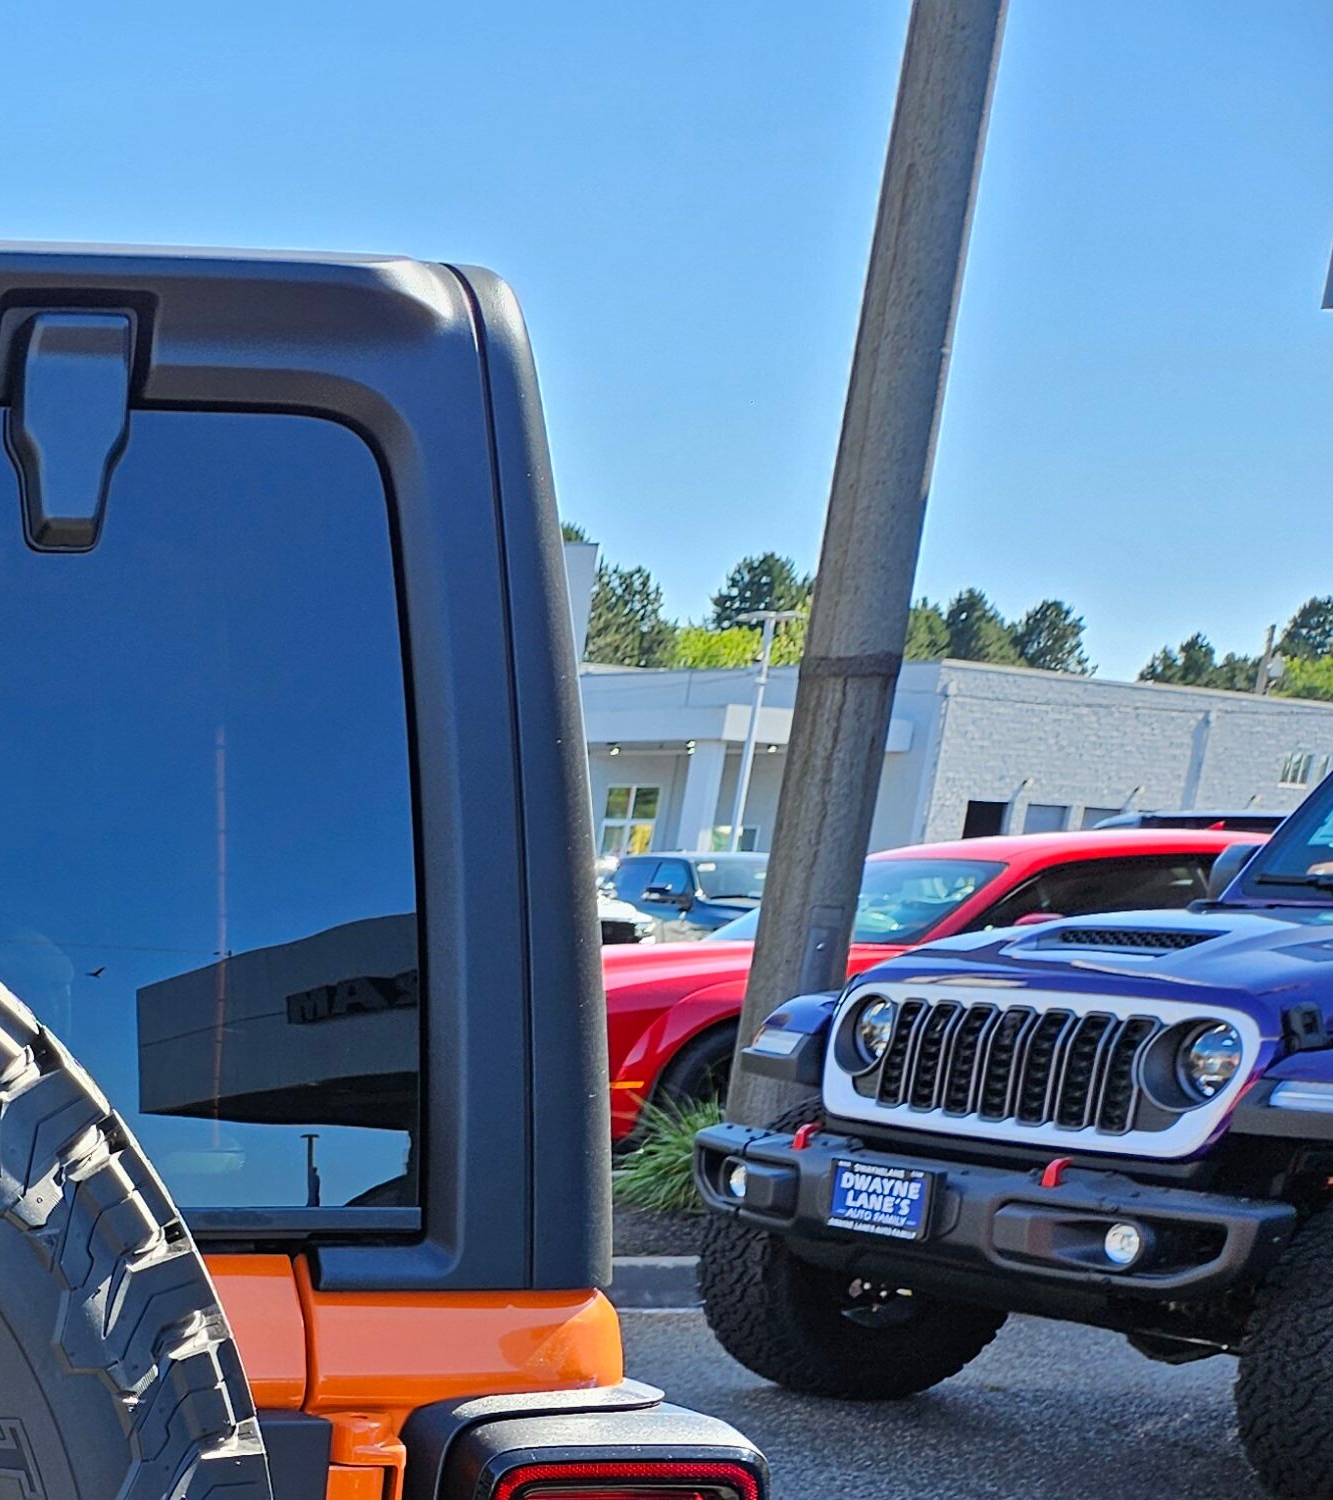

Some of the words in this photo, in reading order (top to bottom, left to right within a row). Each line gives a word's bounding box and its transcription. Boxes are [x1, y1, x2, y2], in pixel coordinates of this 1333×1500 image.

[840, 1171, 921, 1199] DWAYNE
[844, 1208, 872, 1221] AUTO
[845, 1190, 910, 1215] LANE'S
